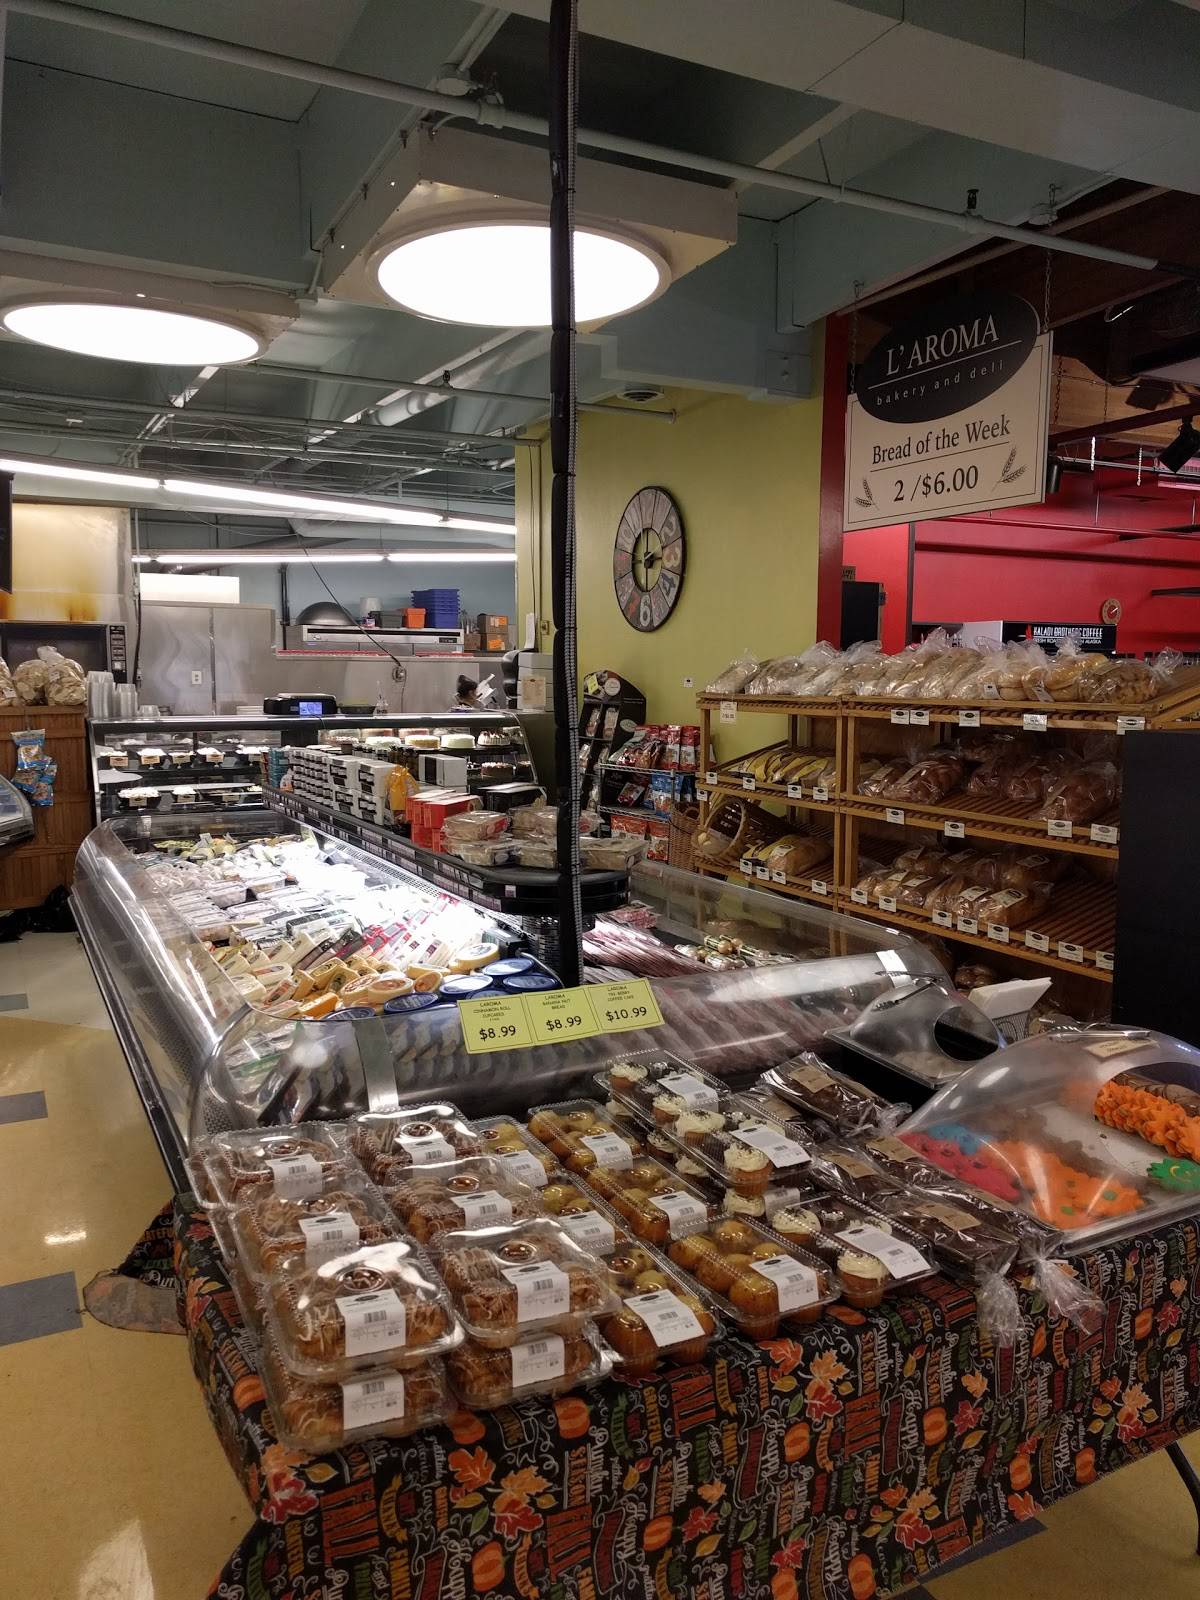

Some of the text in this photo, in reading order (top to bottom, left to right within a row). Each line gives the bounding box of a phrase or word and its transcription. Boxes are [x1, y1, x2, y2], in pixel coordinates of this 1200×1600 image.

[887, 314, 1000, 377] L'AROMA
[877, 359, 1004, 406] bakery and deli
[872, 414, 1011, 465] Bread of the Week
[1083, 627, 1104, 637] COFFEE
[479, 1025, 516, 1042] $8.99
[546, 1015, 582, 1031] $8.99
[605, 1006, 647, 1023] $10.99
[1154, 1239, 1168, 1299] Pumpkin
[1117, 1291, 1138, 1346] Happy
[861, 1330, 875, 1394] SEASON
[870, 1316, 895, 1384] Pumpkin
[927, 1350, 941, 1407] SEASON
[939, 1332, 960, 1398] Pumpkin
[643, 1386, 663, 1447] GRATEFUL
[721, 1421, 738, 1467] FAMILY
[901, 1389, 924, 1450] Happy
[569, 1445, 588, 1506] SEASON
[588, 1425, 610, 1498] Pumpkin
[676, 1440, 695, 1508] Pumpkin
[760, 1417, 787, 1478] Happy
[655, 1459, 673, 1515] SEASON
[319, 1478, 381, 1569] FALL
[616, 1501, 648, 1562] Happy
[824, 1518, 847, 1583] Happy
[371, 1569, 391, 1590] and
